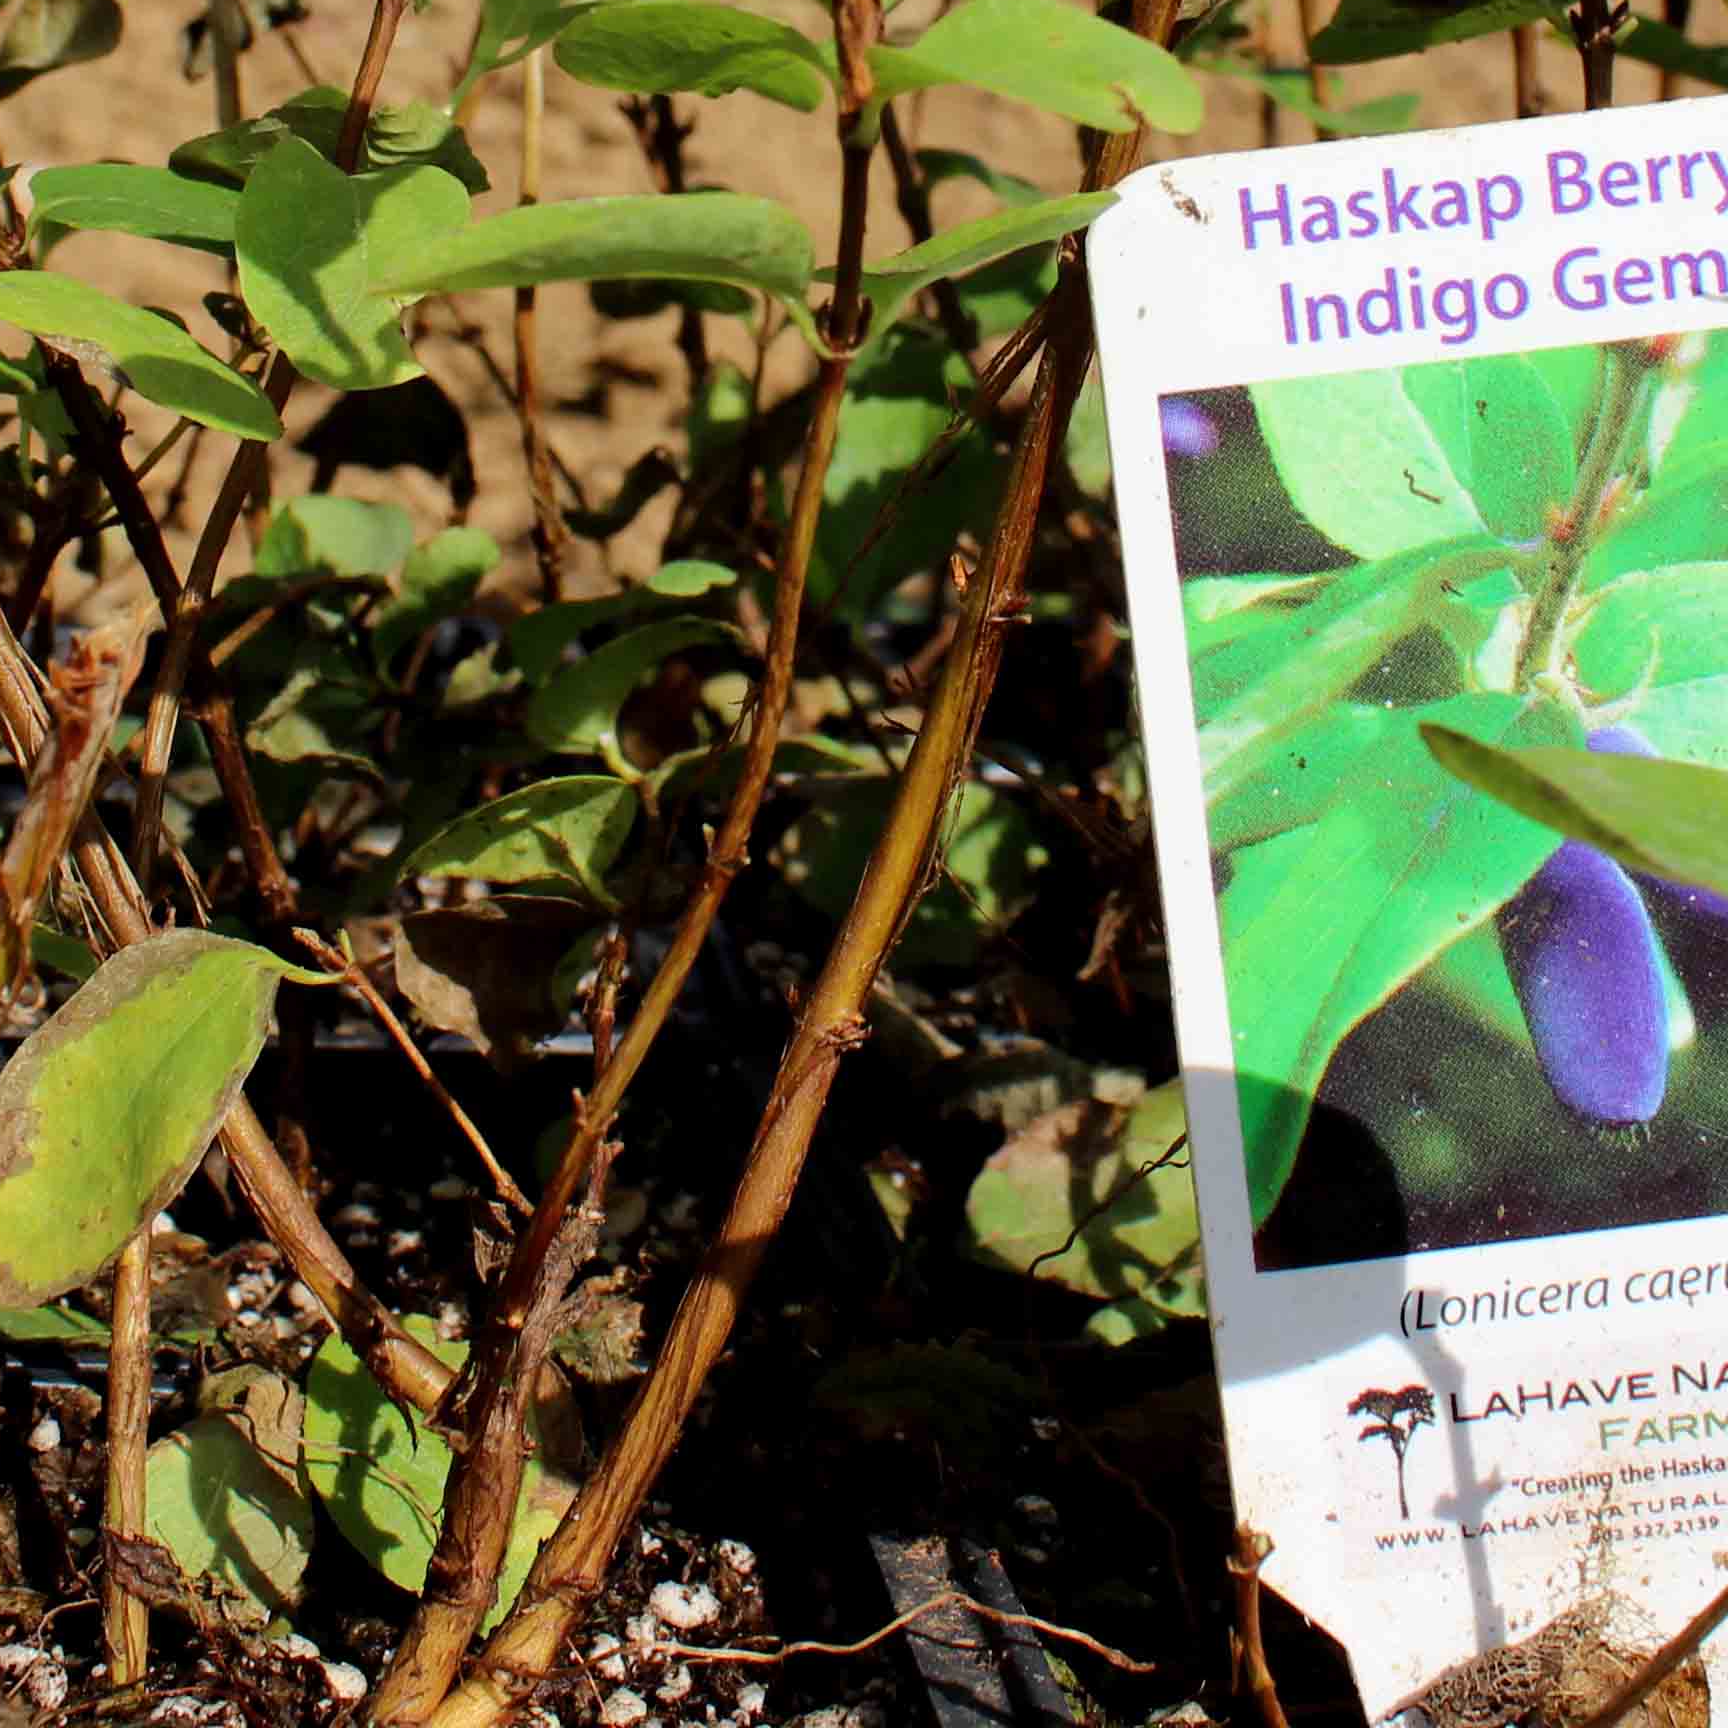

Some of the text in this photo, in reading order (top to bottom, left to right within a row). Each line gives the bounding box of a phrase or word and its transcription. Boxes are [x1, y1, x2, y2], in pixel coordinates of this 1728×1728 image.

[1238, 167, 1525, 249] Haskap
[1279, 264, 1530, 345] Indigo
[1399, 1277, 1610, 1338] (Lonicera
[1449, 1371, 1658, 1423] LAHAVE
[1619, 1464, 1656, 1485] the
